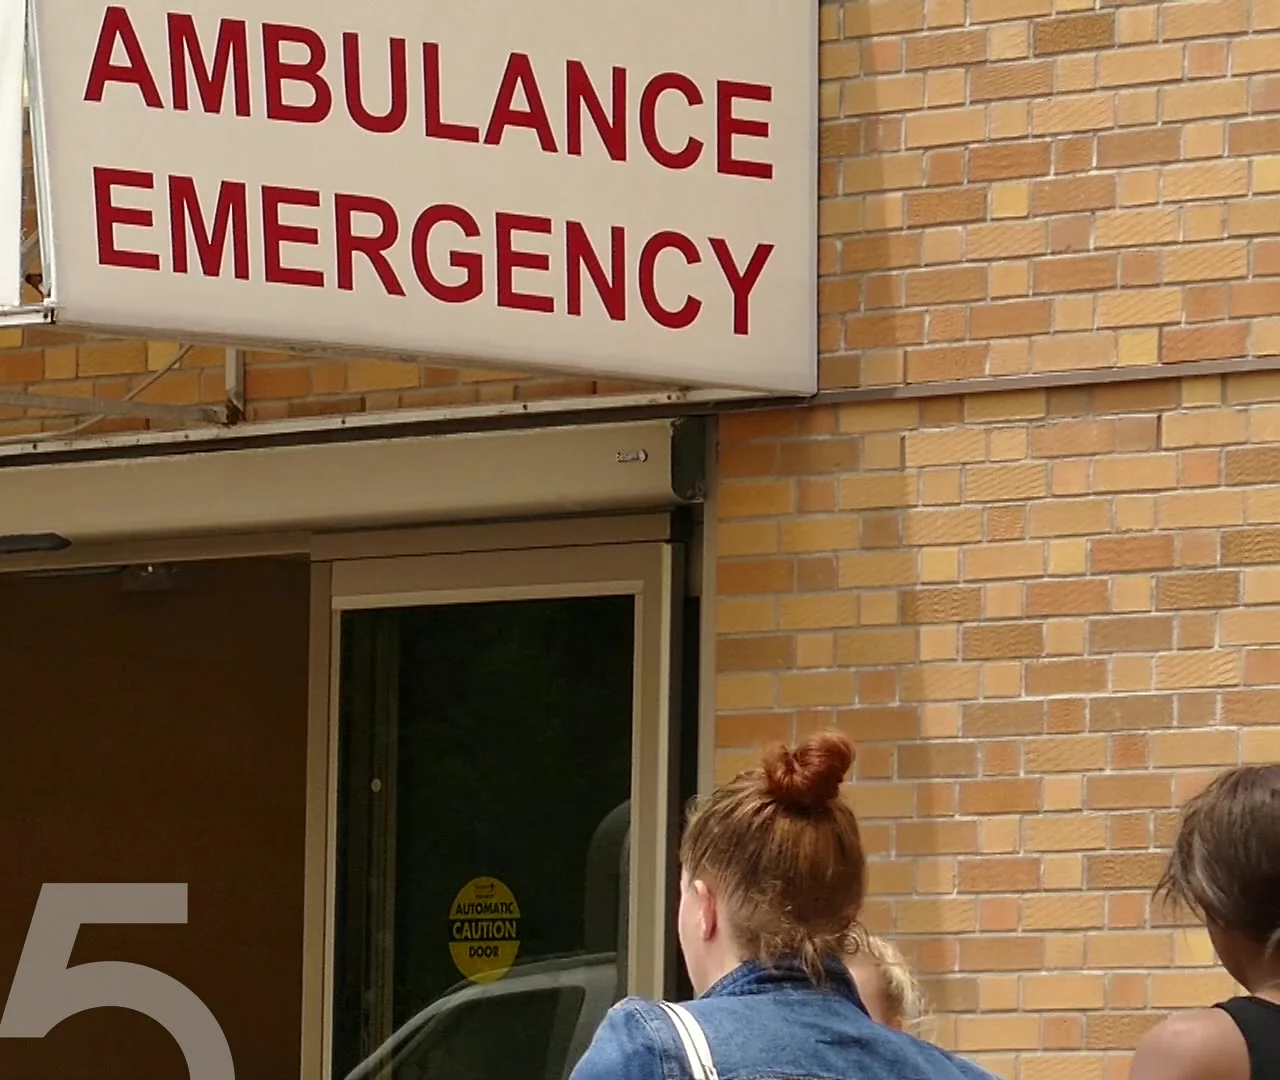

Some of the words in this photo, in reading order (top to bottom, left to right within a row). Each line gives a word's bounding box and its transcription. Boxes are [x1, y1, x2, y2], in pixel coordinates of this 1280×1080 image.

[83, 6, 774, 180] AMBULANCE
[93, 166, 775, 336] EMERGENCY
[456, 902, 514, 914] AUTOMATIC
[452, 920, 517, 939] CAUTION
[469, 946, 499, 957] DOOR
